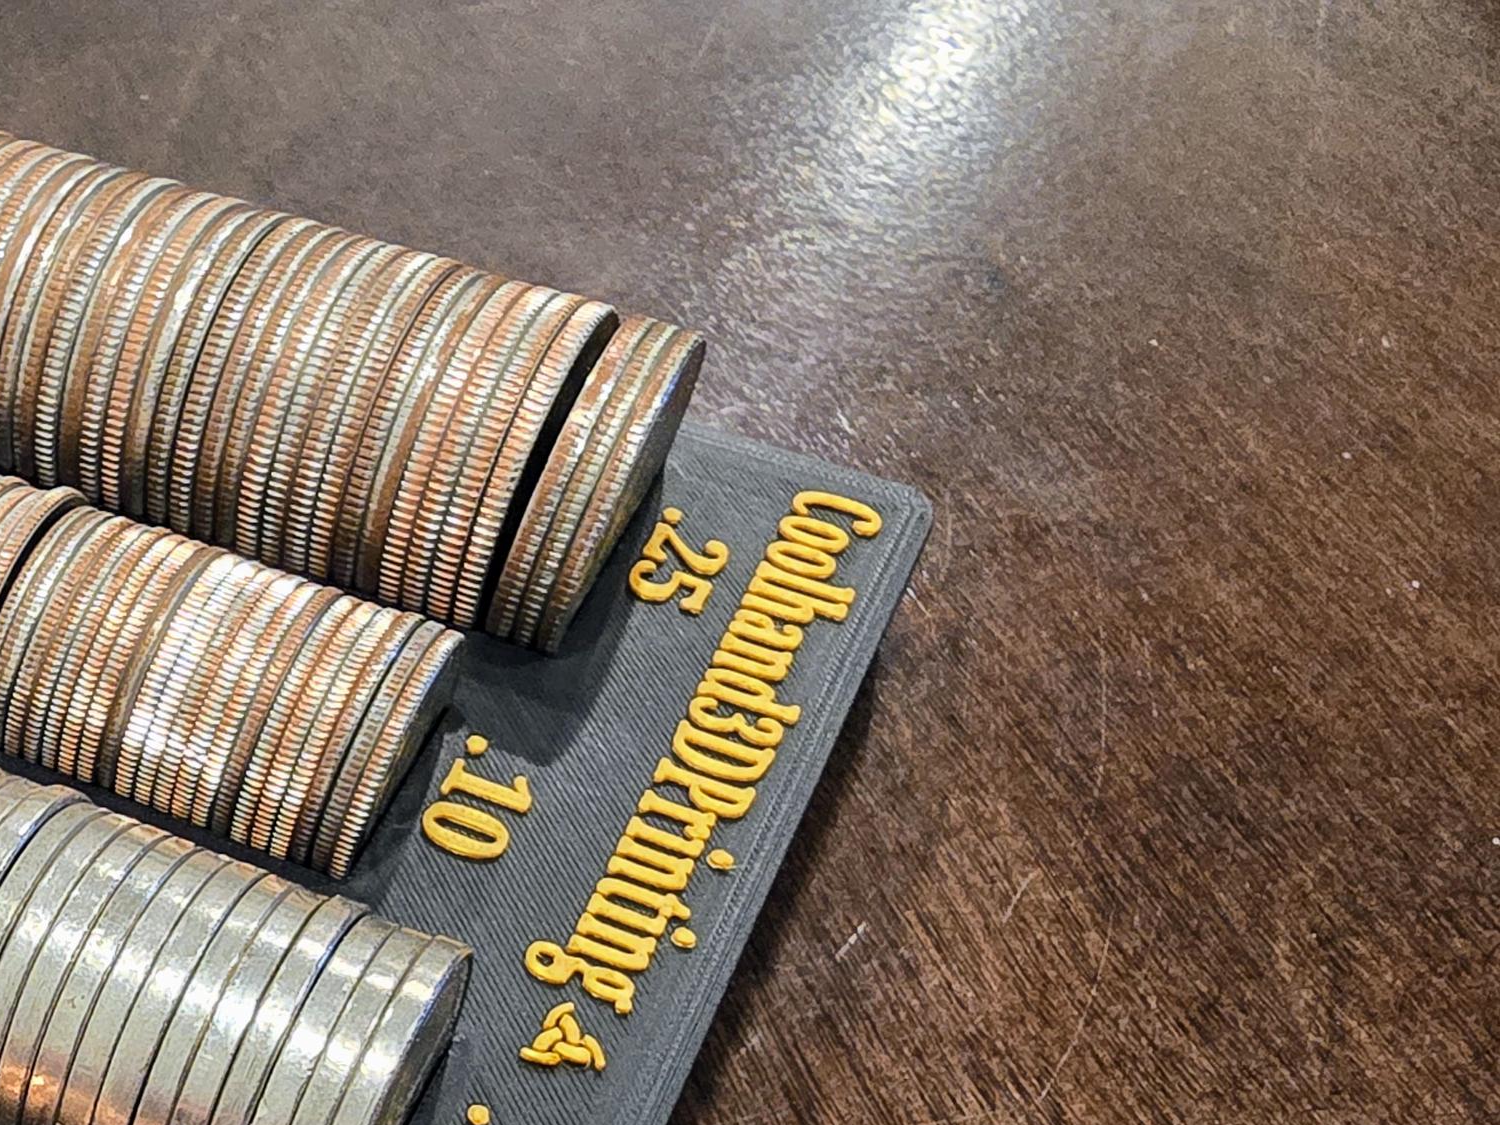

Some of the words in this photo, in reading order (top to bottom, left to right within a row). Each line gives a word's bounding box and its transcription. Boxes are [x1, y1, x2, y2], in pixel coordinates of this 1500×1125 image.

[628, 506, 729, 614] .25
[421, 733, 532, 861] .10
[524, 490, 883, 1015] Coolhand3DPrinting
